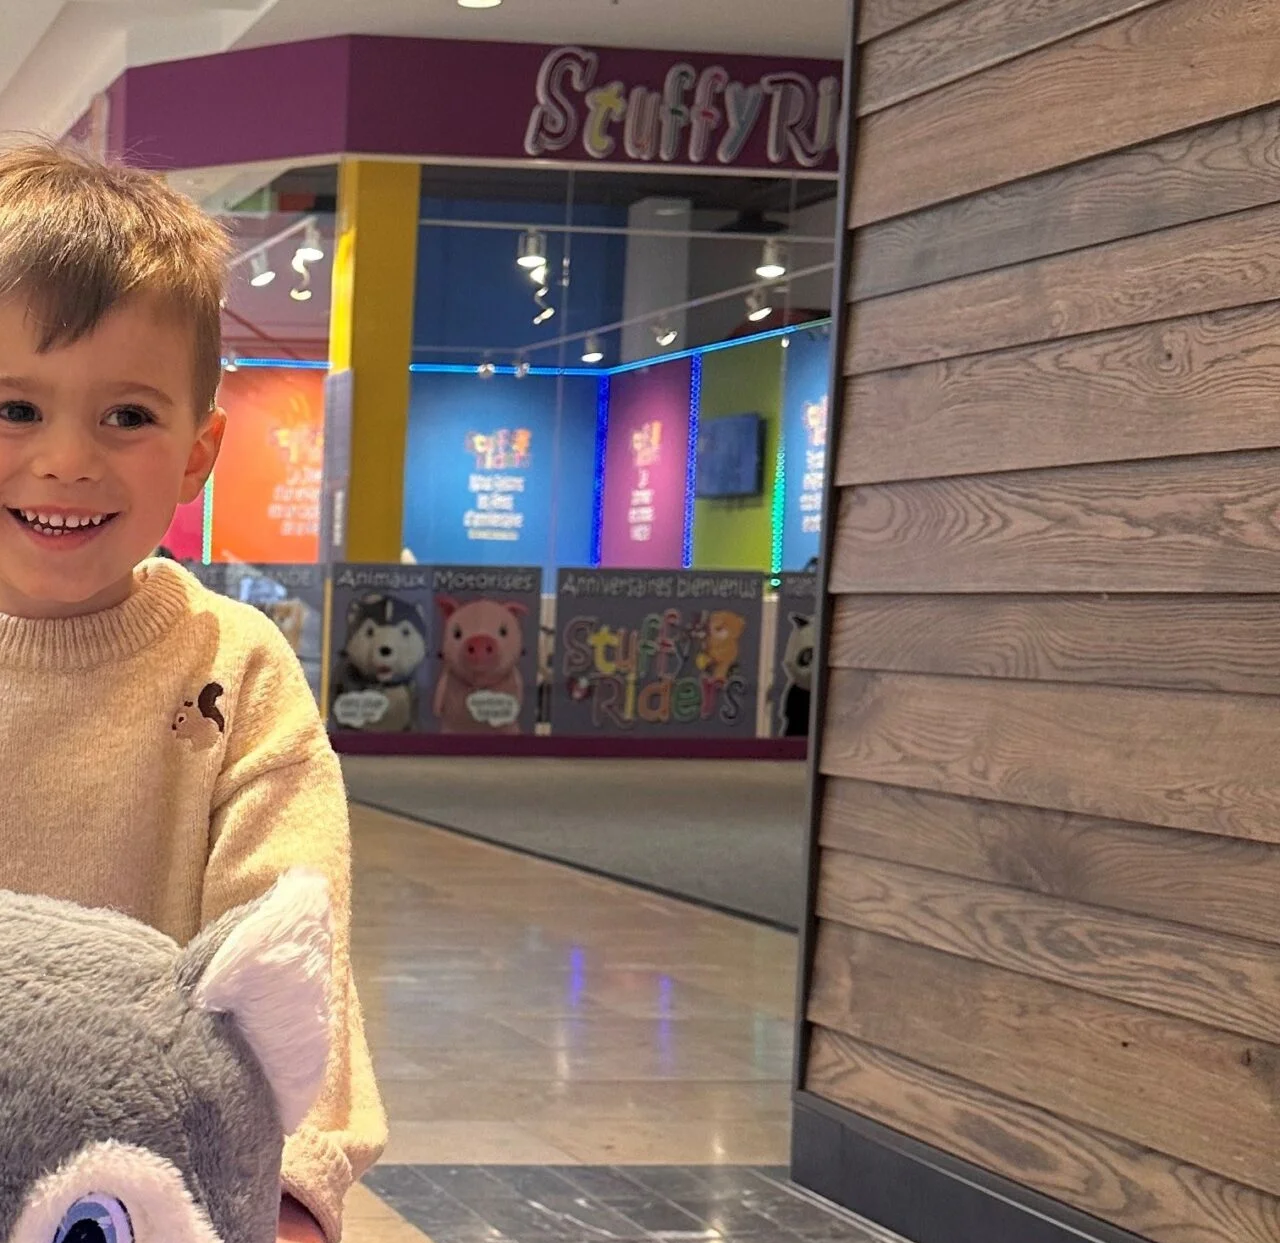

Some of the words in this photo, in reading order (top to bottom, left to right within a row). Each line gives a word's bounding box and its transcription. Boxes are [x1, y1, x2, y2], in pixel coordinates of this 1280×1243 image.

[336, 568, 426, 589] Animaux
[560, 574, 673, 597] Anniversaires
[676, 576, 759, 599] bienvenus
[562, 608, 691, 679] Stuffy
[588, 668, 746, 730] Riders
